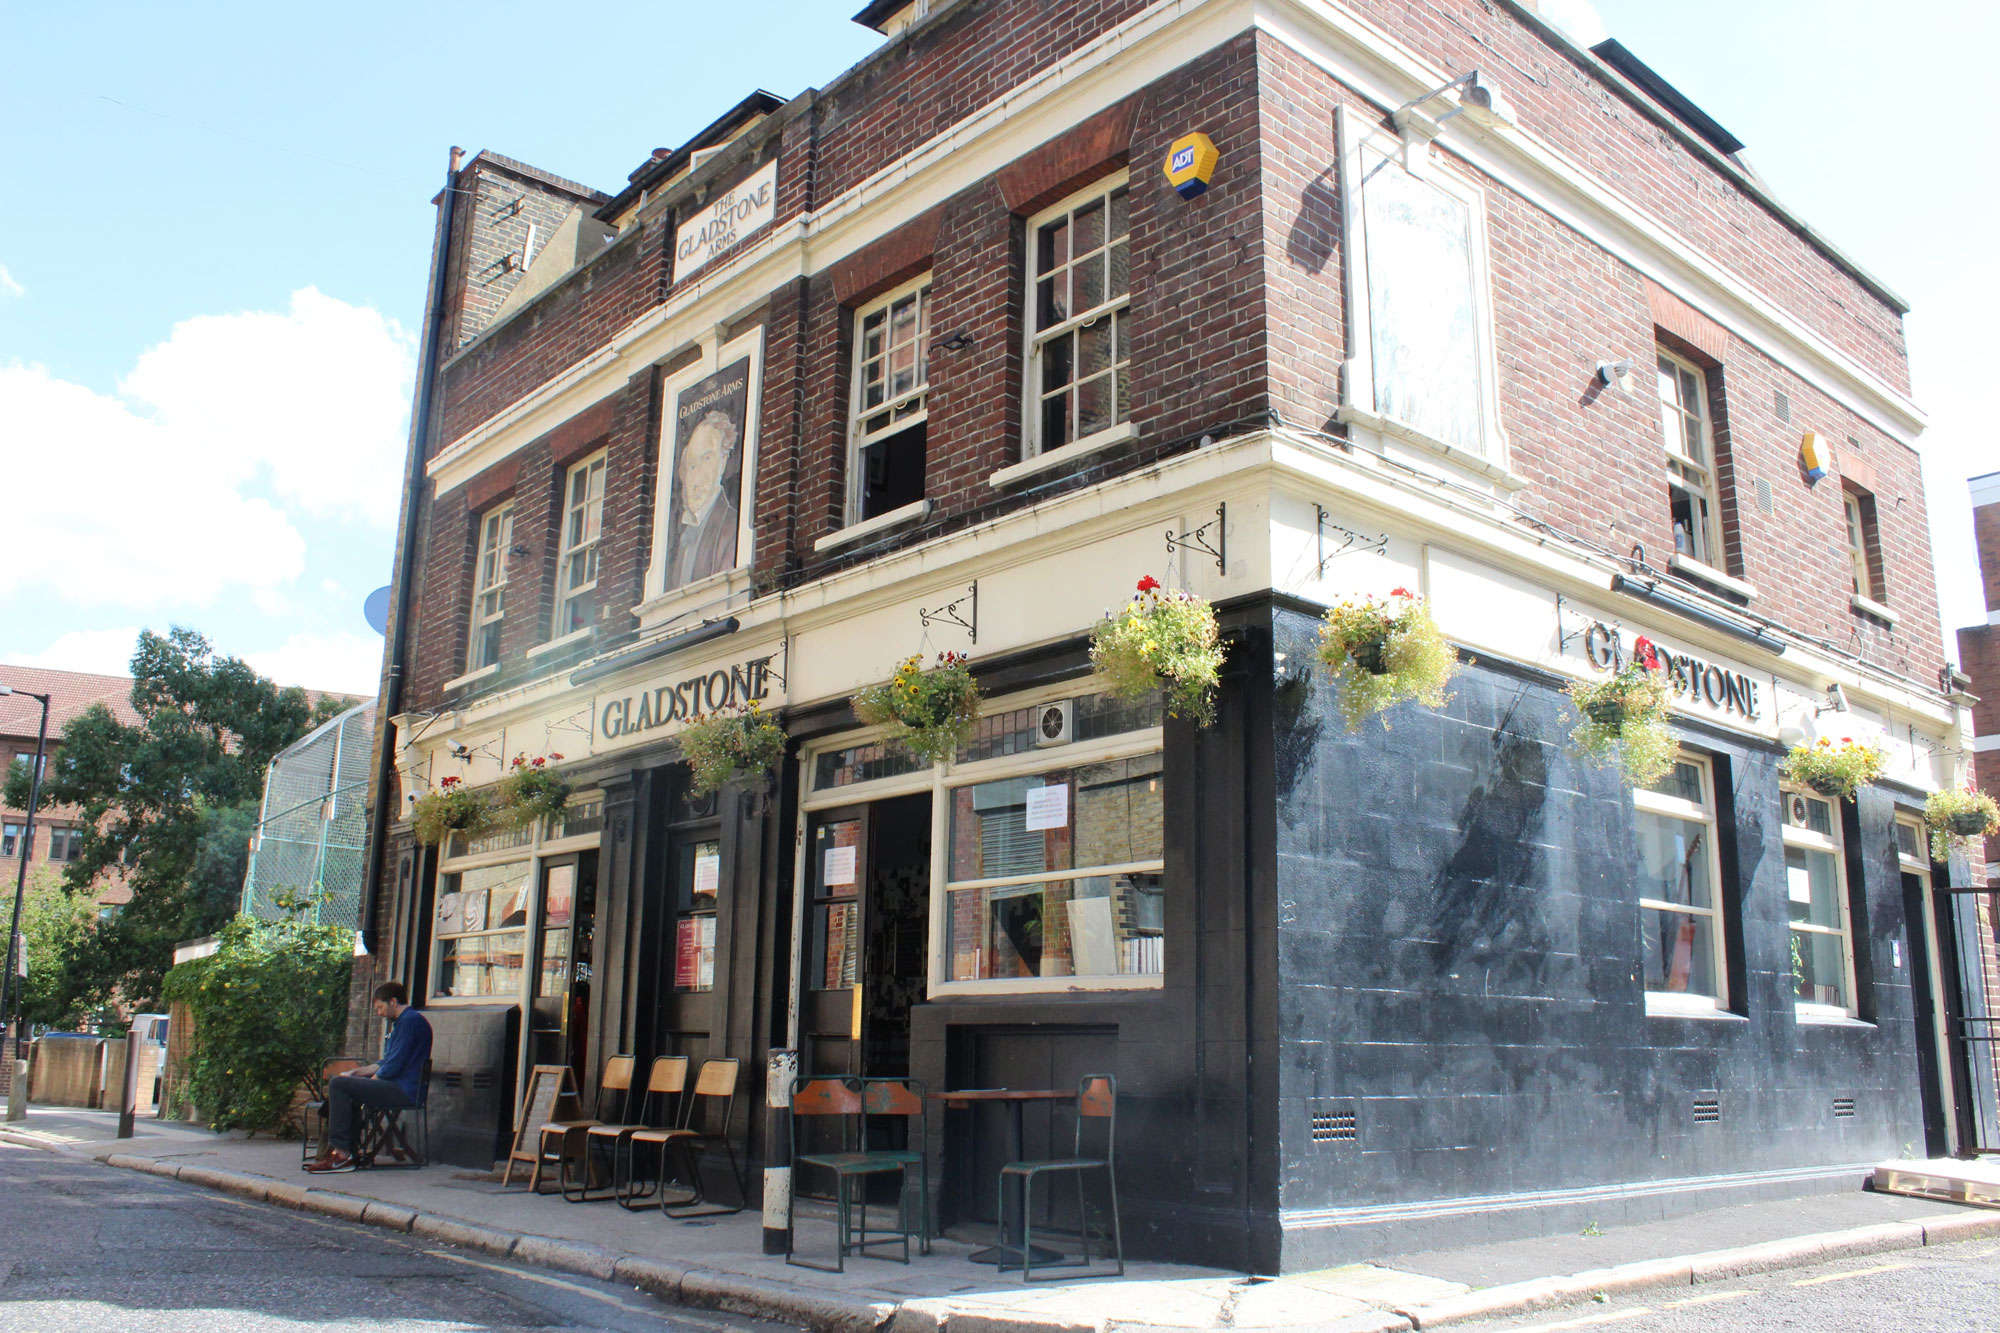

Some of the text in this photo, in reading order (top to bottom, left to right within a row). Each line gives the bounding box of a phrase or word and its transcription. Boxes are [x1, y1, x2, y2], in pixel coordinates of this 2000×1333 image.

[1172, 149, 1194, 171] ADT
[678, 180, 771, 261] GLADSTONE
[713, 191, 735, 216] THE
[706, 228, 737, 260] ARMS
[680, 389, 721, 419] GLADSTONE
[721, 377, 743, 398] ARMS
[601, 656, 770, 739] GLADSTONE
